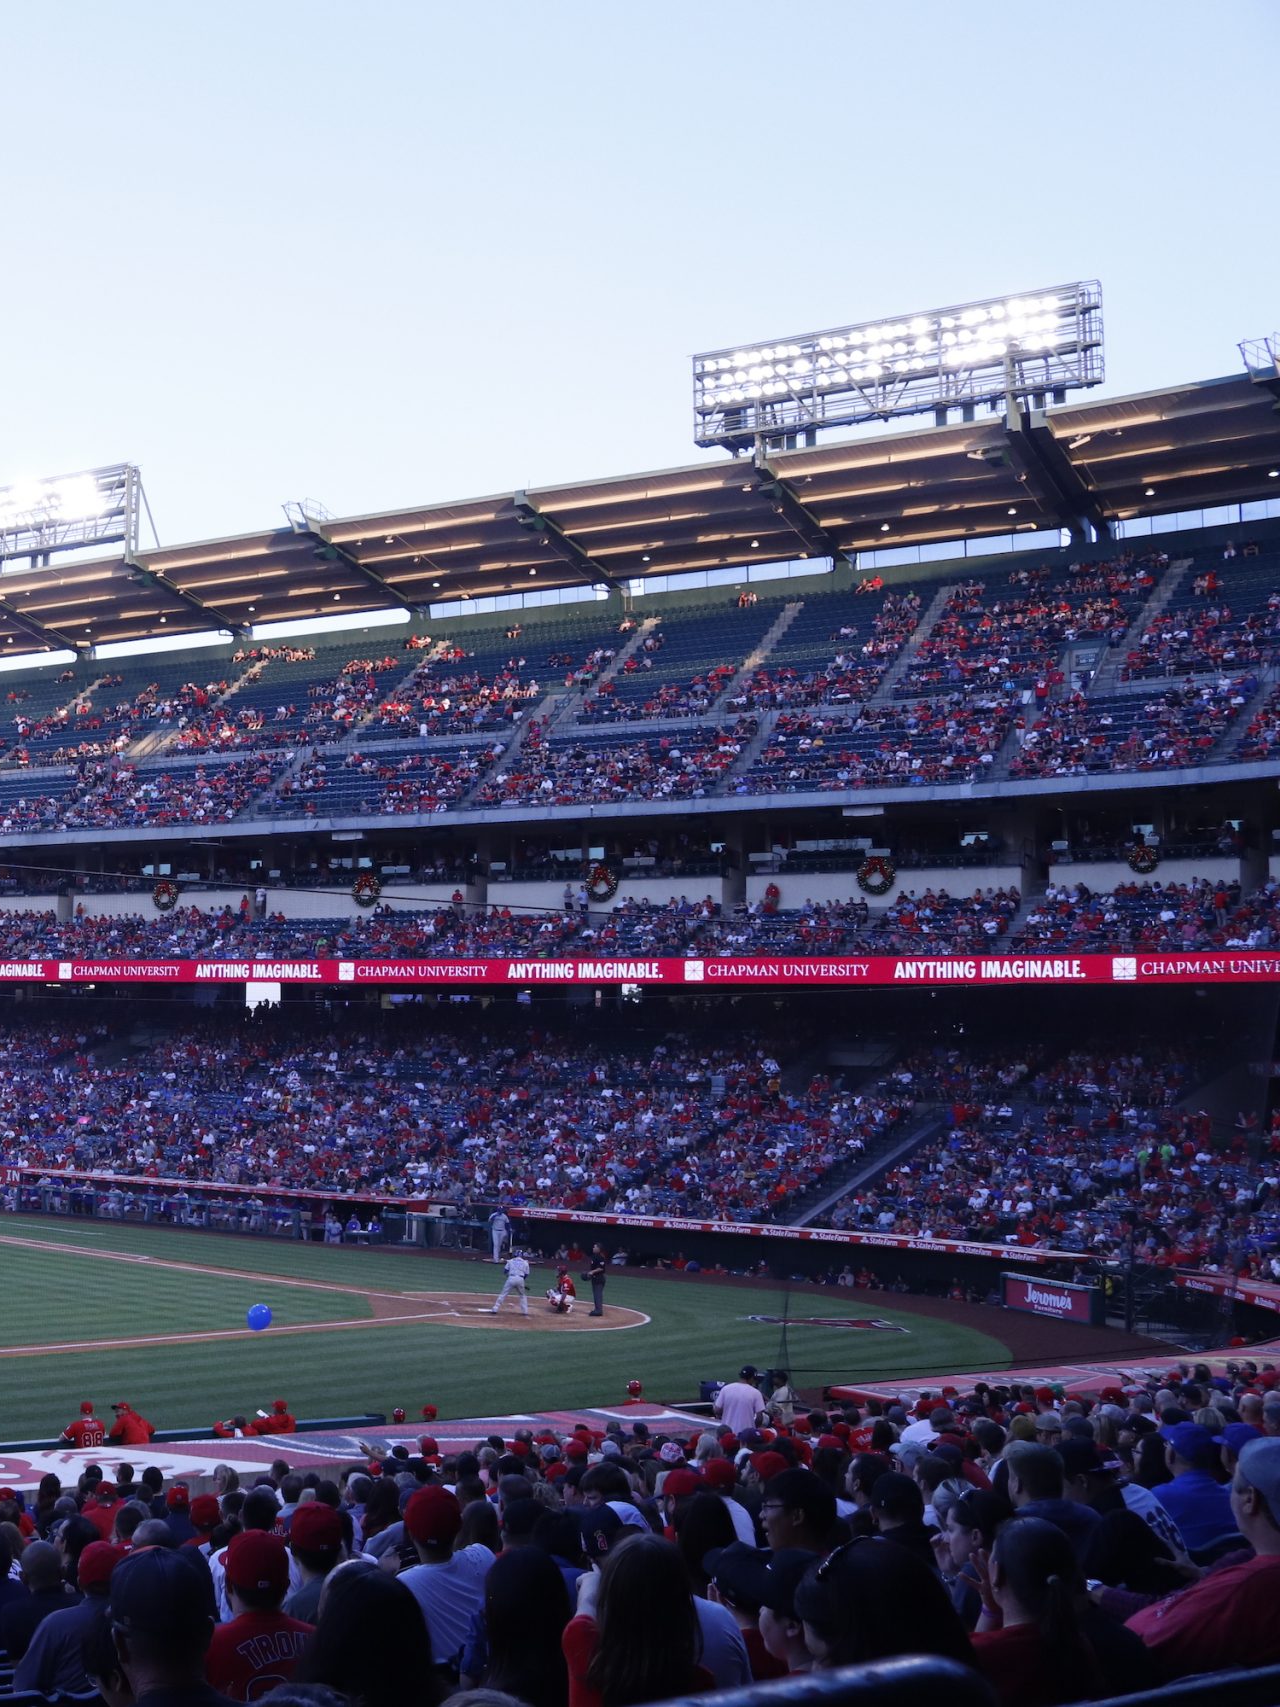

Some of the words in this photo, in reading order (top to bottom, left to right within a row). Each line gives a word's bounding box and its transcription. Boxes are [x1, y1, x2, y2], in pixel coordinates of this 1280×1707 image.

[73, 966, 121, 976] CHAPMAN
[123, 966, 180, 976] UNIVERSITY
[195, 963, 250, 978] ANYTHING
[252, 963, 322, 979] IMAGINABLE.
[357, 965, 414, 977] CHAPMAN
[418, 965, 488, 977] UNIVERSITY
[507, 963, 575, 979] ANYTHING
[577, 963, 663, 979] IMAGINABLE.
[707, 964, 779, 977] CHAPMAN
[783, 963, 869, 977] UNIVERSITY
[894, 960, 977, 979] ANYTHING
[980, 960, 1086, 979] IMAGINABLE.
[1141, 960, 1225, 975] CHAPMAN
[81, 1431, 104, 1448] 88
